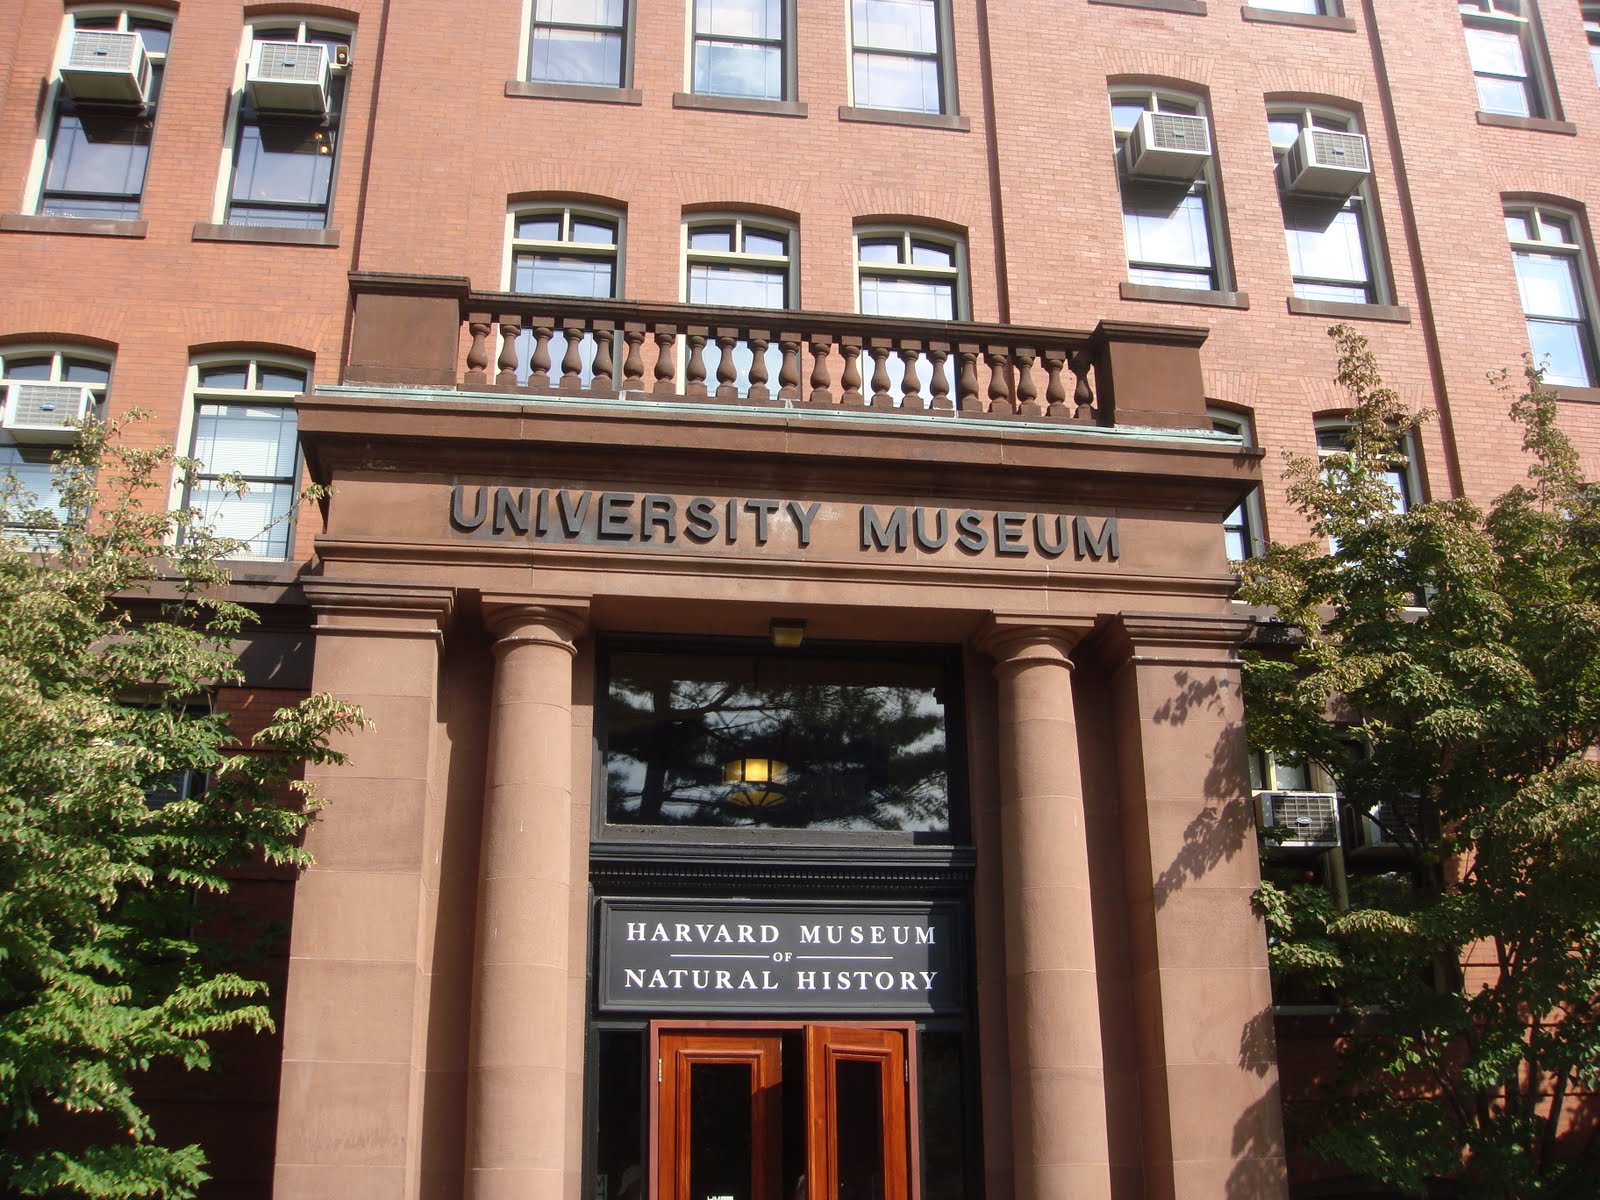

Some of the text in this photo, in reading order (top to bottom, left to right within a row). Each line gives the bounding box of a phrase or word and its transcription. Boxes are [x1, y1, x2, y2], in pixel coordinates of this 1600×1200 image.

[450, 485, 1120, 562] UNIVERSITY MUSEUM
[626, 922, 936, 945] HARVARD MUSEUM
[772, 951, 793, 963] OF
[624, 968, 938, 991] NATURAL HISTORY
